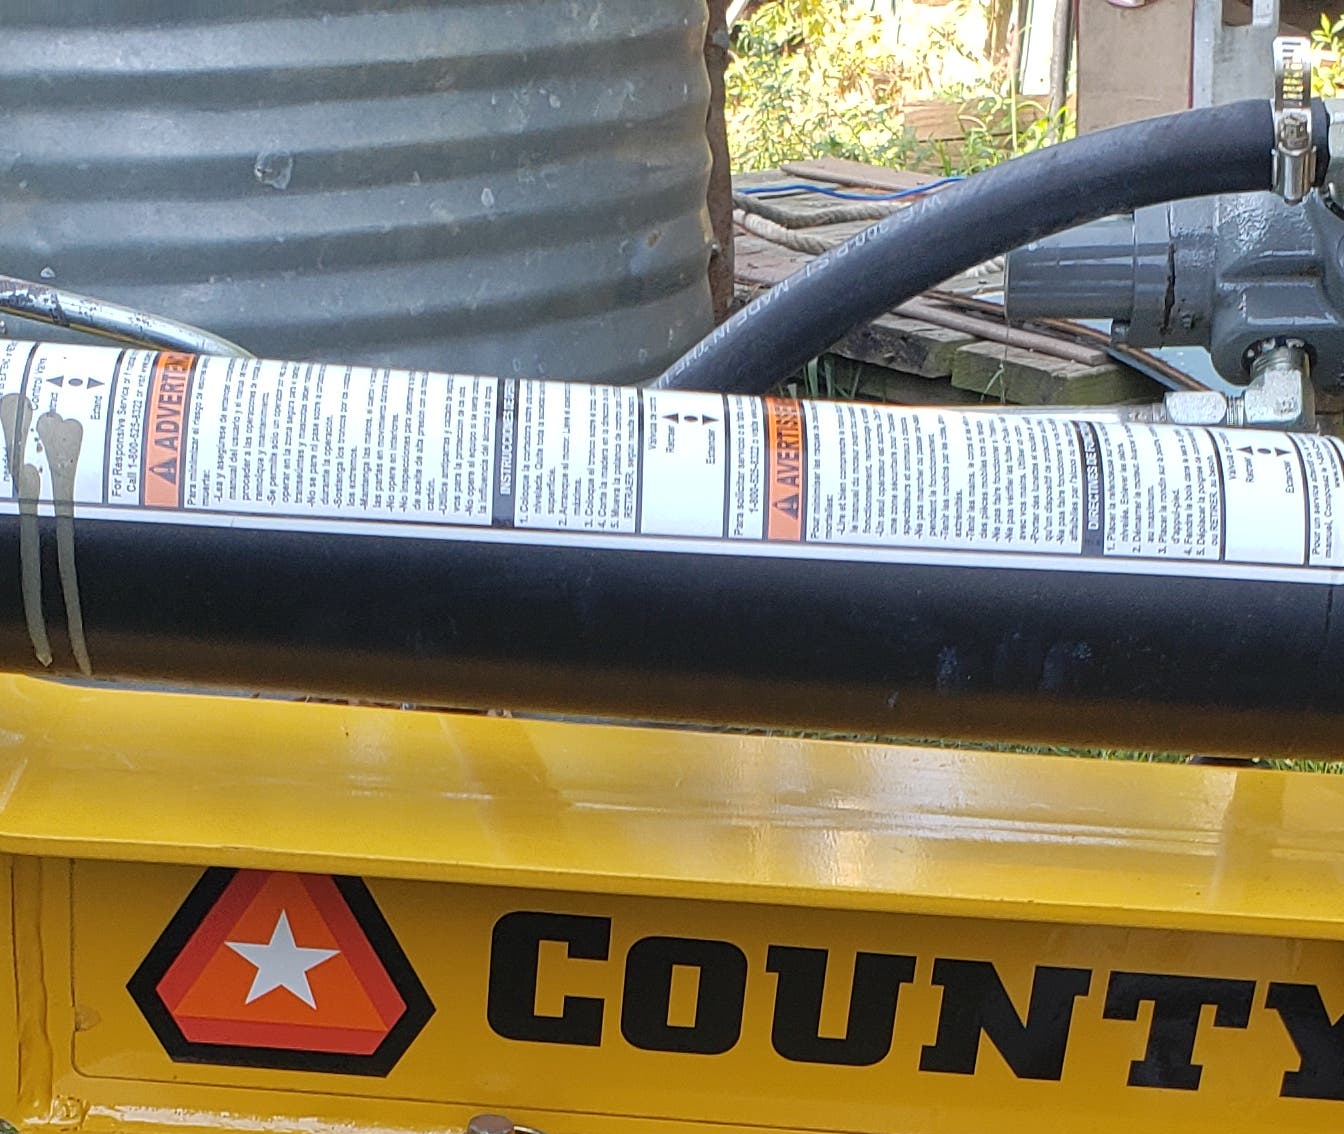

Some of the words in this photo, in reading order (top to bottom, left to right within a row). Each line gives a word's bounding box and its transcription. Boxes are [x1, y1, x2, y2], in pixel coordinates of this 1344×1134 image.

[737, 280, 788, 326] MADE
[713, 324, 731, 345] IN
[113, 419, 125, 476] Responsive
[112, 480, 121, 497] For
[127, 473, 137, 492] Call
